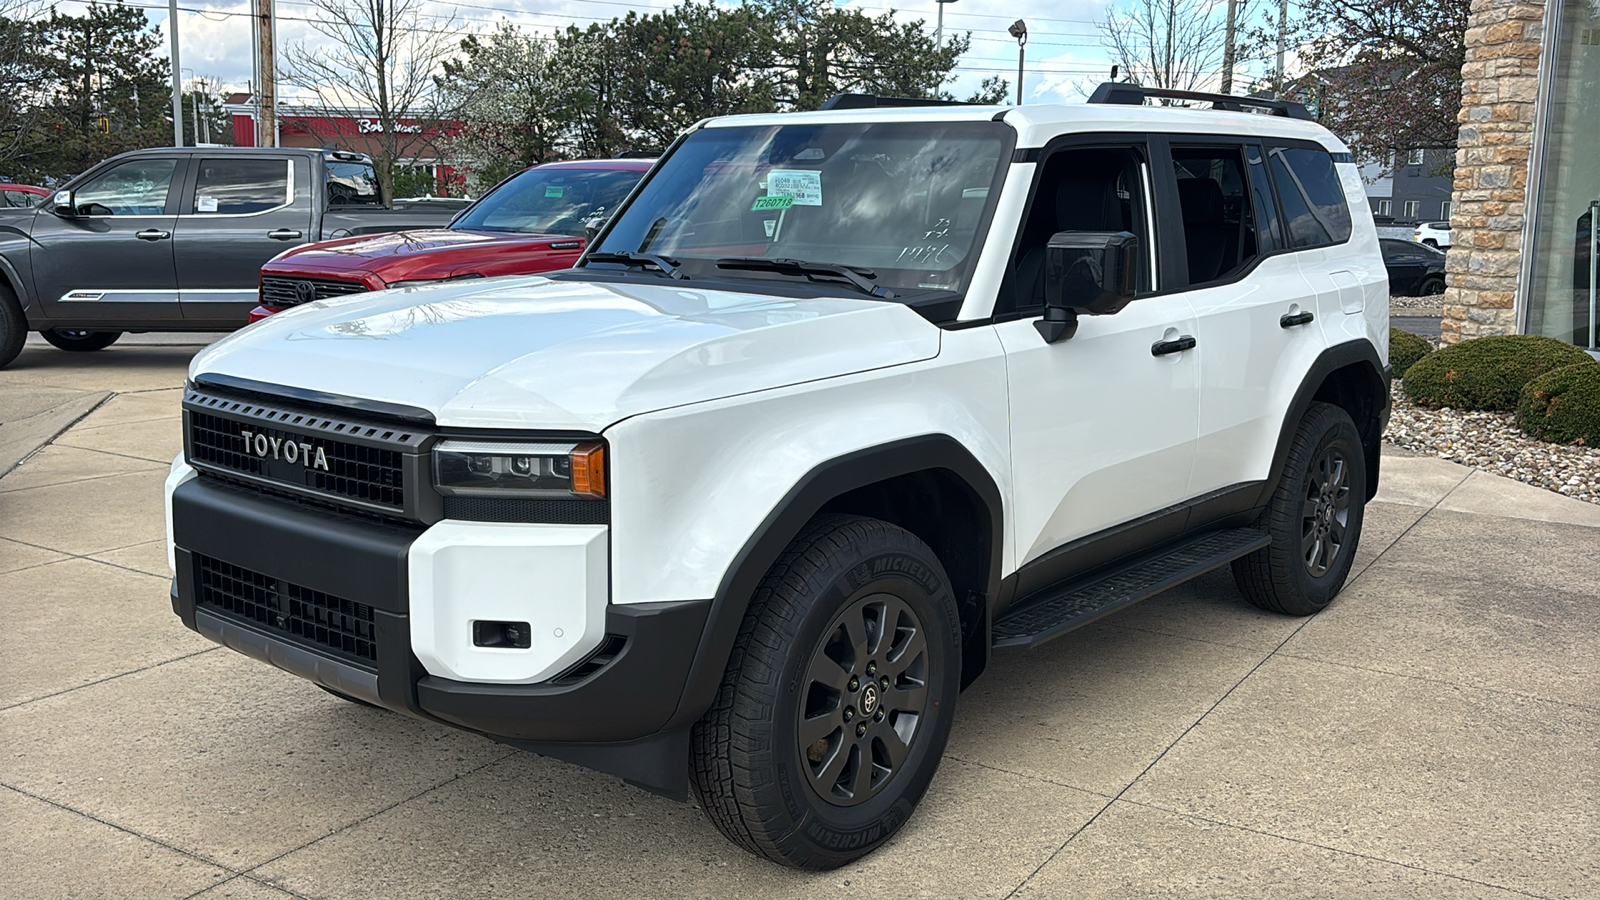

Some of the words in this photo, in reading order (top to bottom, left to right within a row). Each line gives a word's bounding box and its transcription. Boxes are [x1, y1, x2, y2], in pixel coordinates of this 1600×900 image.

[357, 119, 384, 134] Bob
[755, 198, 793, 208] T260718
[241, 430, 329, 471] TOYOTA
[872, 557, 937, 590] MICHELIN
[806, 821, 881, 849] MICHELIN
